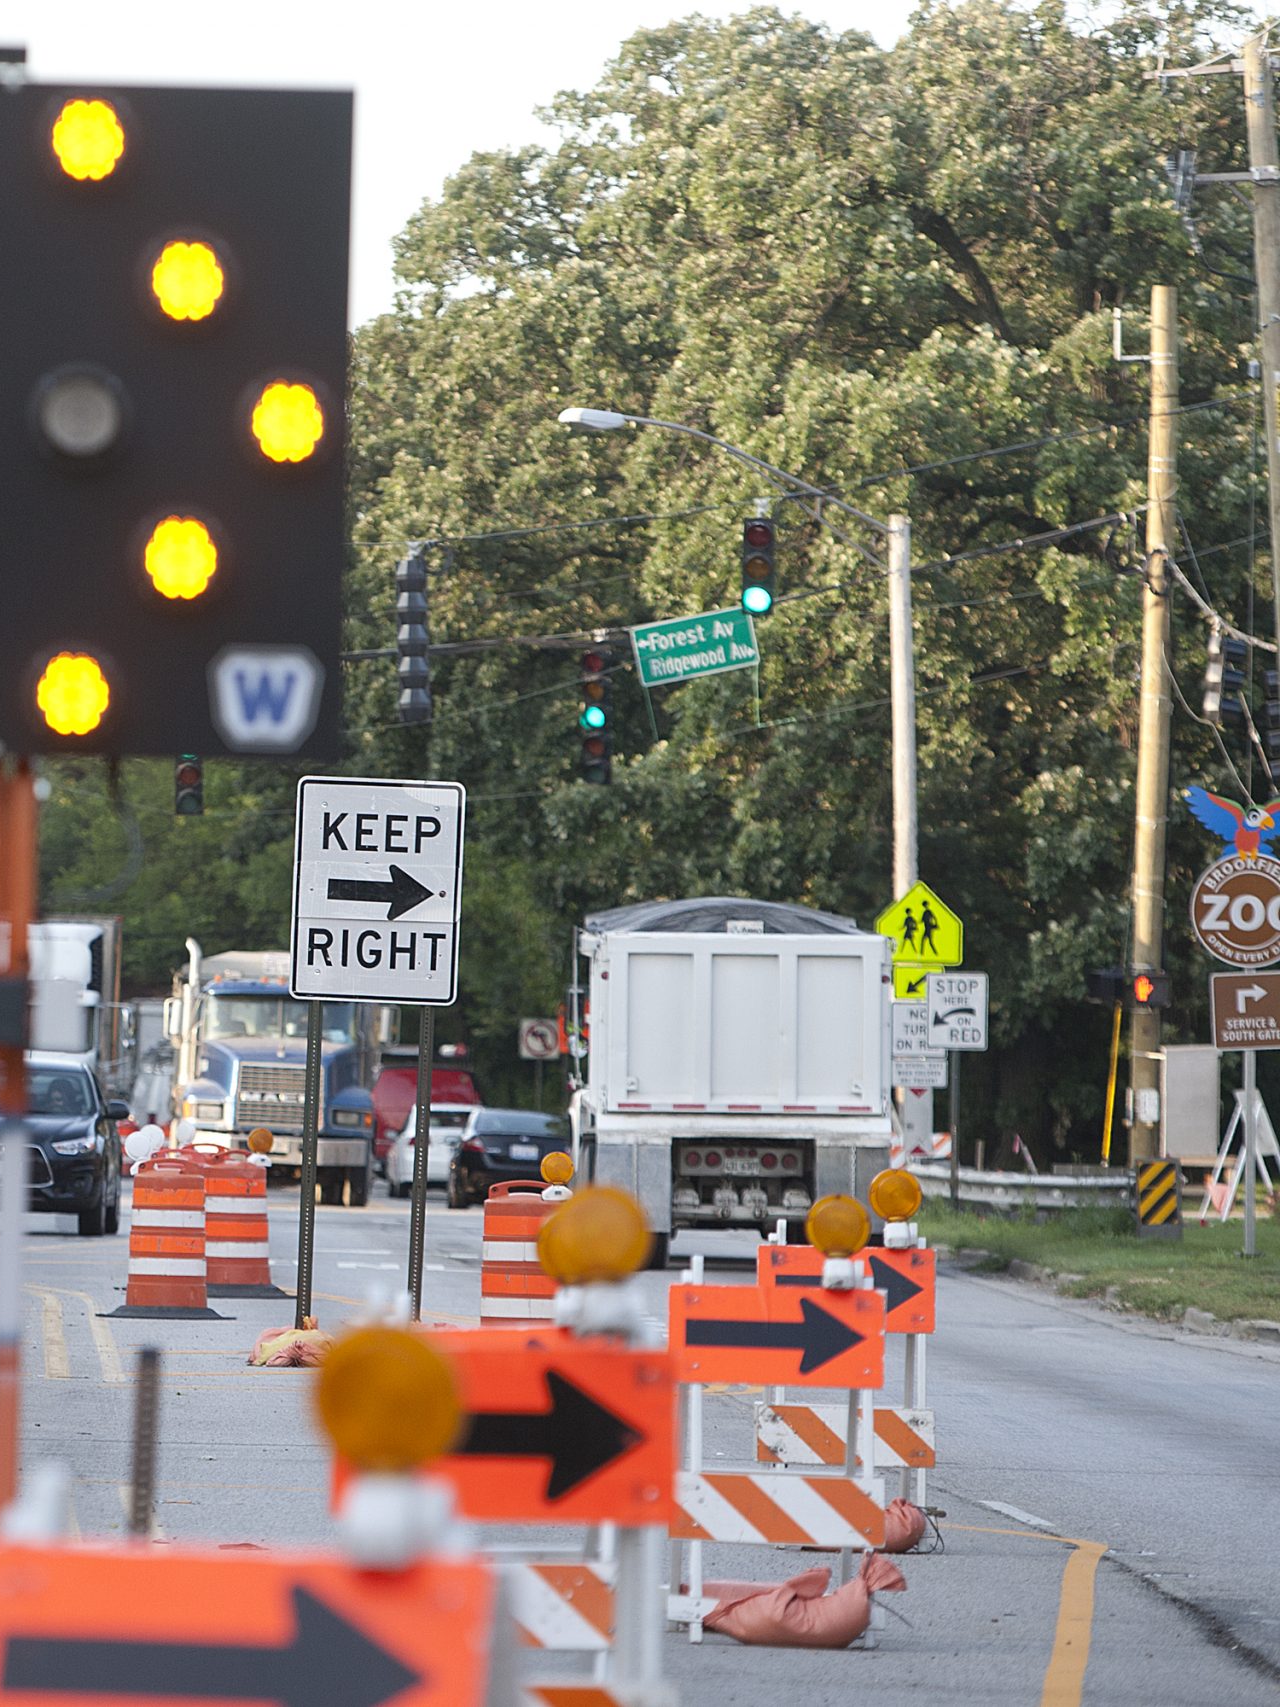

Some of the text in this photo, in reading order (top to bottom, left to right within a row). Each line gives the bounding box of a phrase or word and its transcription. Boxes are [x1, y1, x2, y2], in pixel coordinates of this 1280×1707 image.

[647, 620, 734, 652] Forest Av
[649, 645, 726, 676] Ridgewood
[234, 670, 297, 725] W
[322, 812, 441, 854] KEEP
[1204, 859, 1280, 890] BROOKFIE
[307, 928, 447, 971] RIGHT
[1208, 934, 1234, 958] OPEN
[1236, 950, 1270, 962] EVERY
[936, 980, 979, 994] STOP
[944, 997, 968, 1005] HERE
[905, 1024, 927, 1036] TUR
[1226, 1016, 1276, 1030] SERVICE &
[896, 1041, 913, 1050] ON
[950, 1029, 981, 1043] RED
[1222, 1029, 1256, 1041] SOUTH
